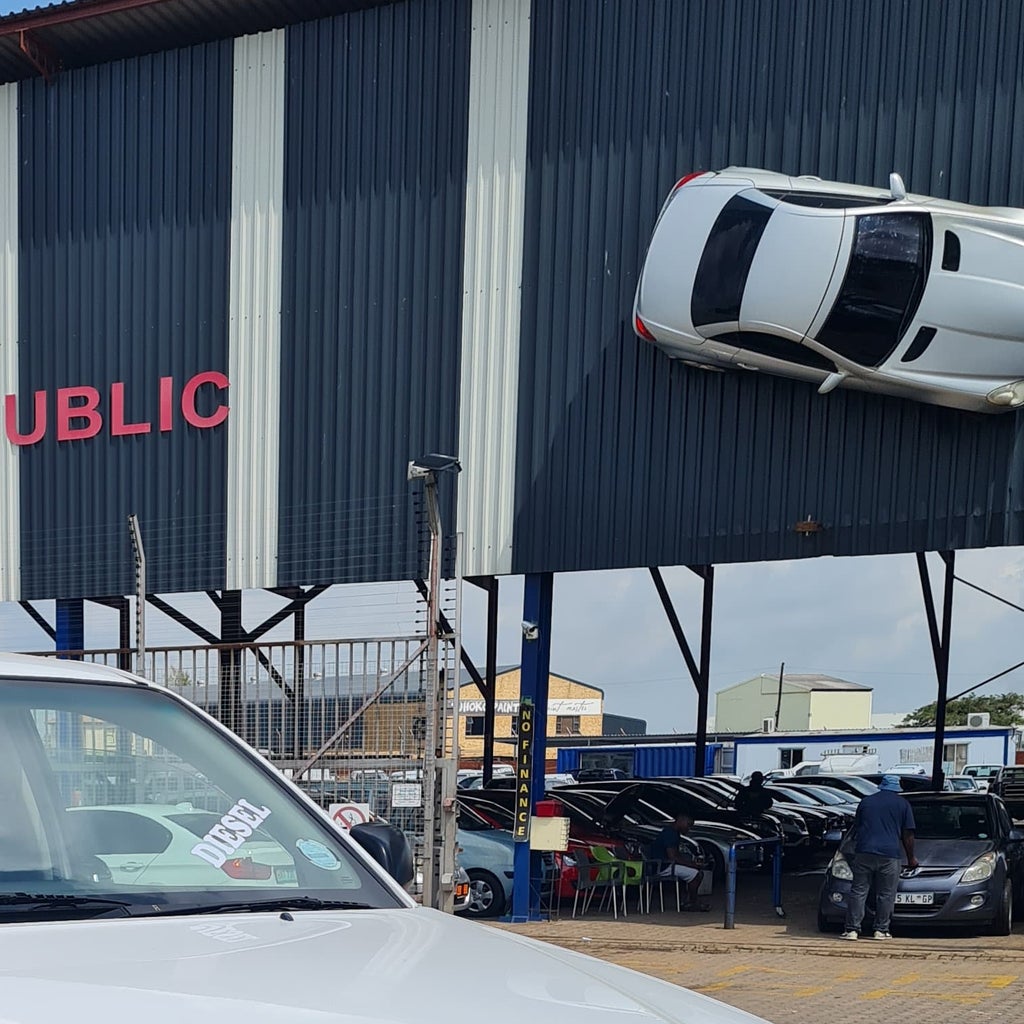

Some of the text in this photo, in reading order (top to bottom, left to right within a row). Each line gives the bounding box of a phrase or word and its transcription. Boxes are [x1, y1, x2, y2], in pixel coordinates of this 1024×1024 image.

[517, 711, 531, 836] NO FINANCE
[191, 798, 272, 869] DIESEL
[922, 894, 933, 904] GP
